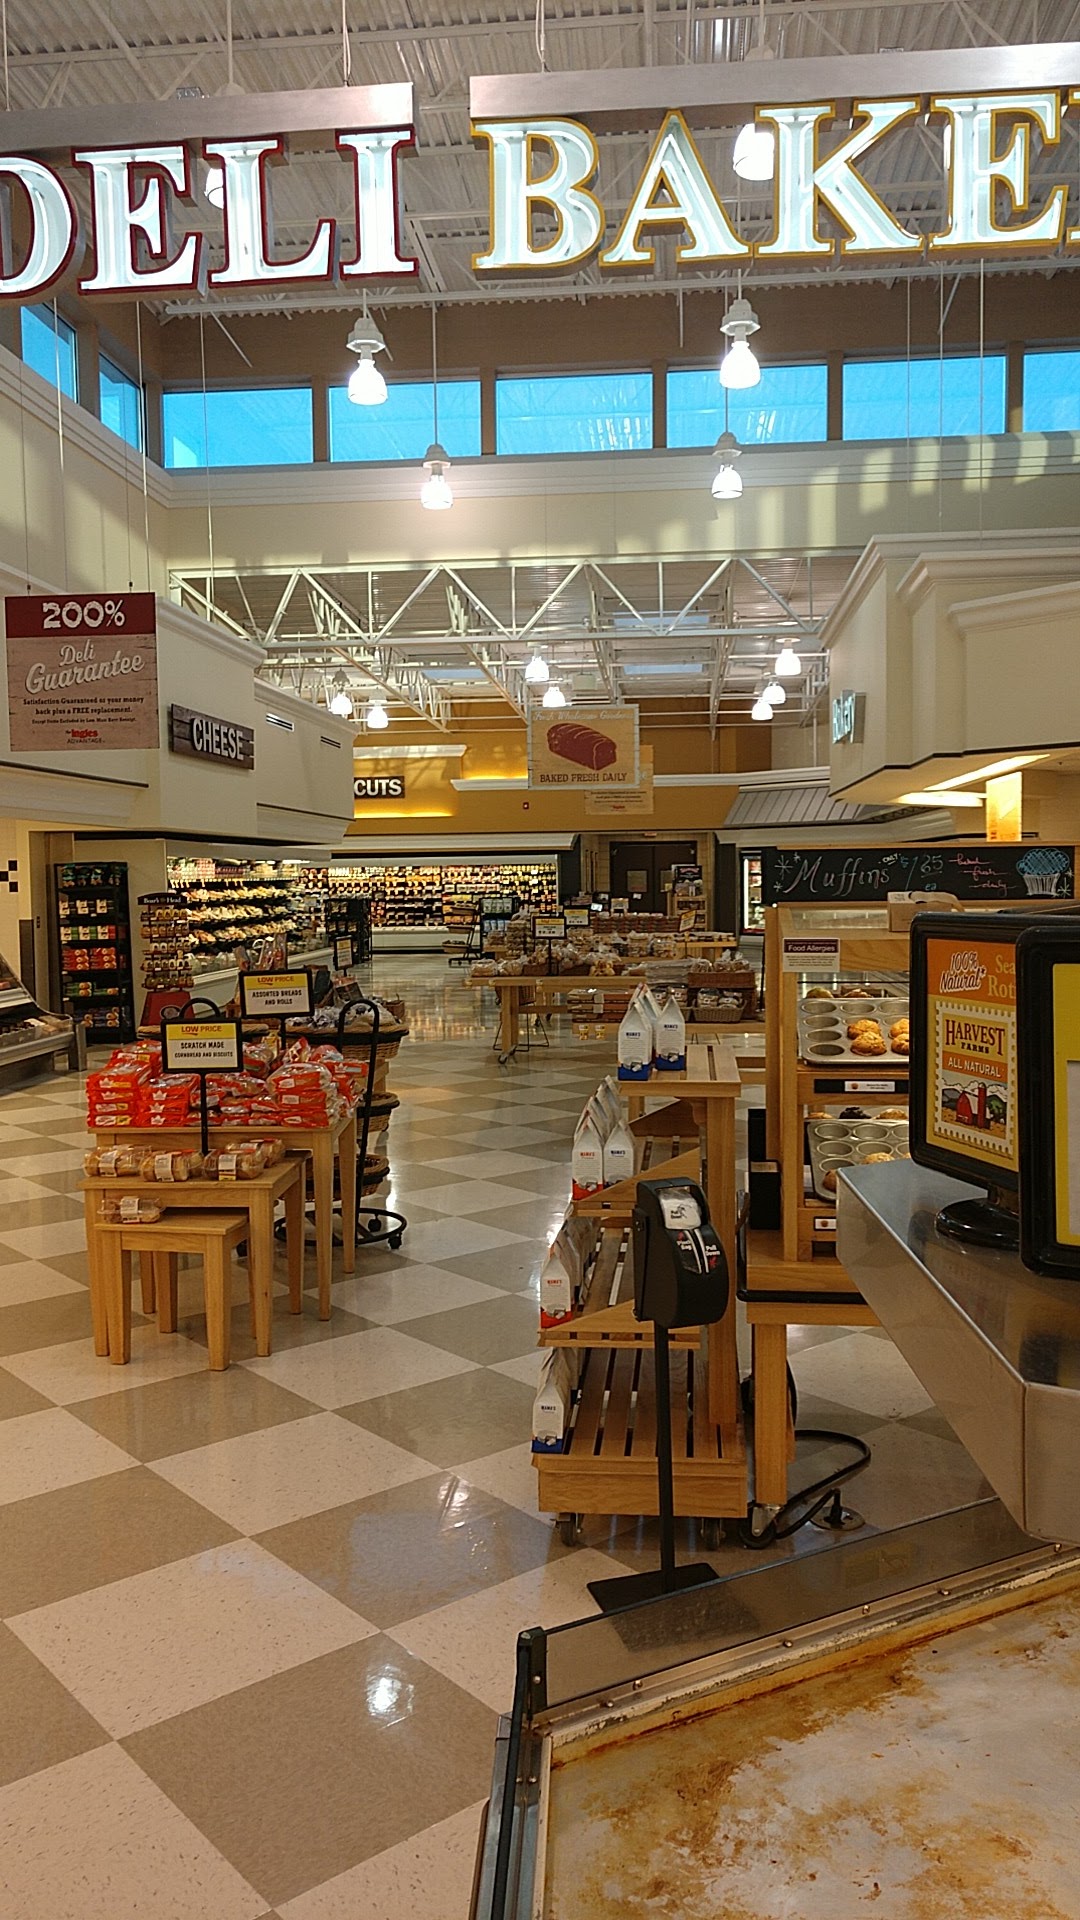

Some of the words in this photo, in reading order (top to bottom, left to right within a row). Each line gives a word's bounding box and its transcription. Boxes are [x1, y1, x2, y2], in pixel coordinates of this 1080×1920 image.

[470, 88, 1080, 270] BAKE
[0, 125, 419, 299] DELI
[42, 600, 126, 629] 200%
[59, 640, 96, 667] Deli
[25, 650, 145, 694] Guarantee
[52, 708, 66, 716] plus
[90, 707, 132, 715] replacement.
[192, 718, 244, 760] CHEESE
[354, 779, 402, 796] CUTS
[540, 774, 568, 783] BAKED
[572, 773, 599, 782] FRESH
[602, 772, 627, 782] DAILY
[783, 856, 890, 897] Muffins
[806, 944, 836, 953] Allergies
[950, 951, 979, 974] 100%
[945, 1019, 1006, 1056] HARVEST
[960, 1042, 990, 1054] FARMS
[948, 1056, 962, 1069] ALL
[964, 1060, 1001, 1078] NATURAL
